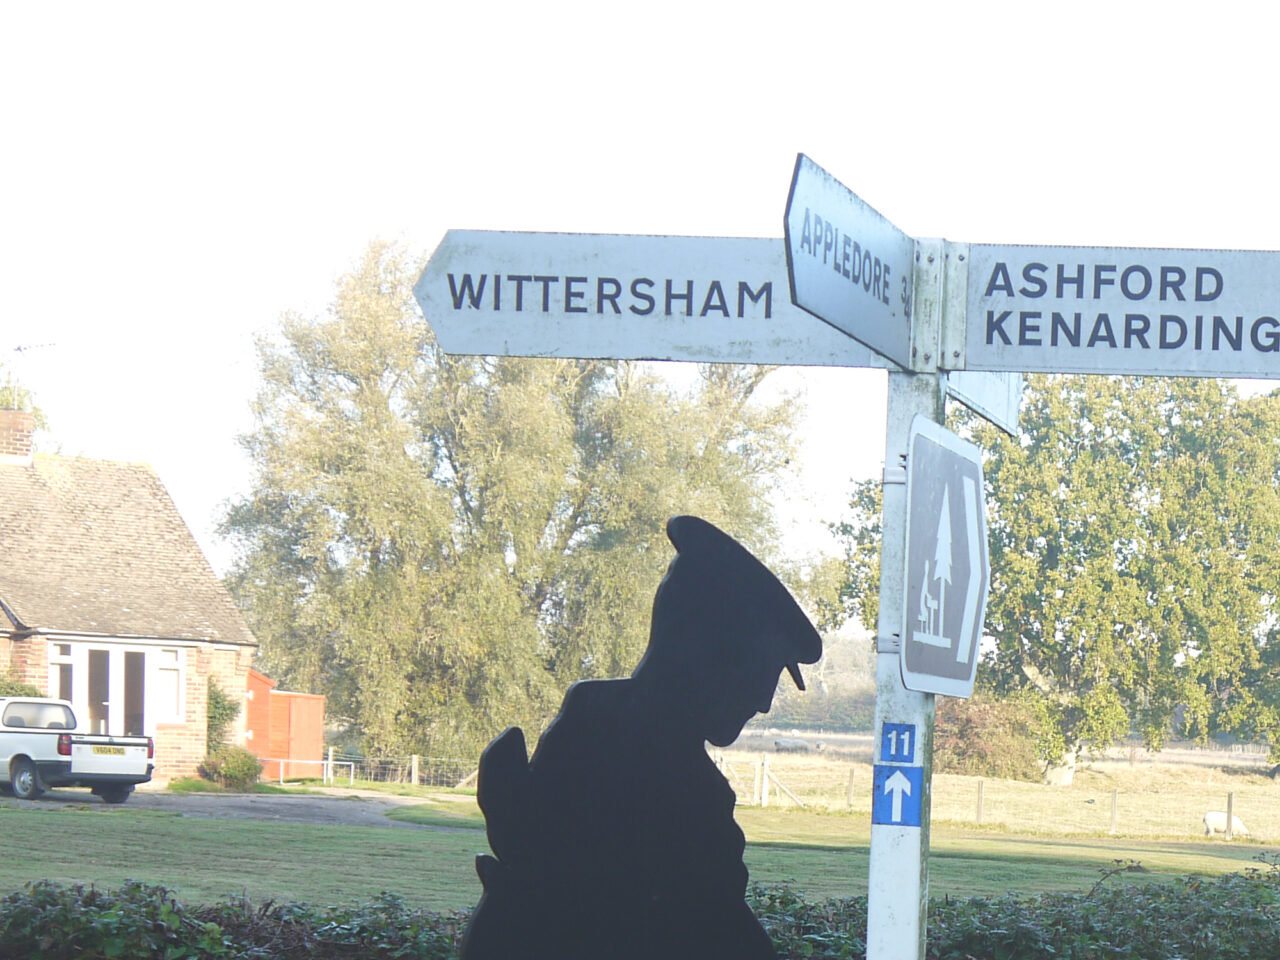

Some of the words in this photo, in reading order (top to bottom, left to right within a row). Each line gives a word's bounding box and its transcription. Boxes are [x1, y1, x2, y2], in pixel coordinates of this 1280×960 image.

[800, 207, 891, 306] APPLEDORE
[446, 273, 773, 320] WITTERSHAM
[984, 262, 1224, 302] ASHFORD
[888, 730, 910, 756] 11
